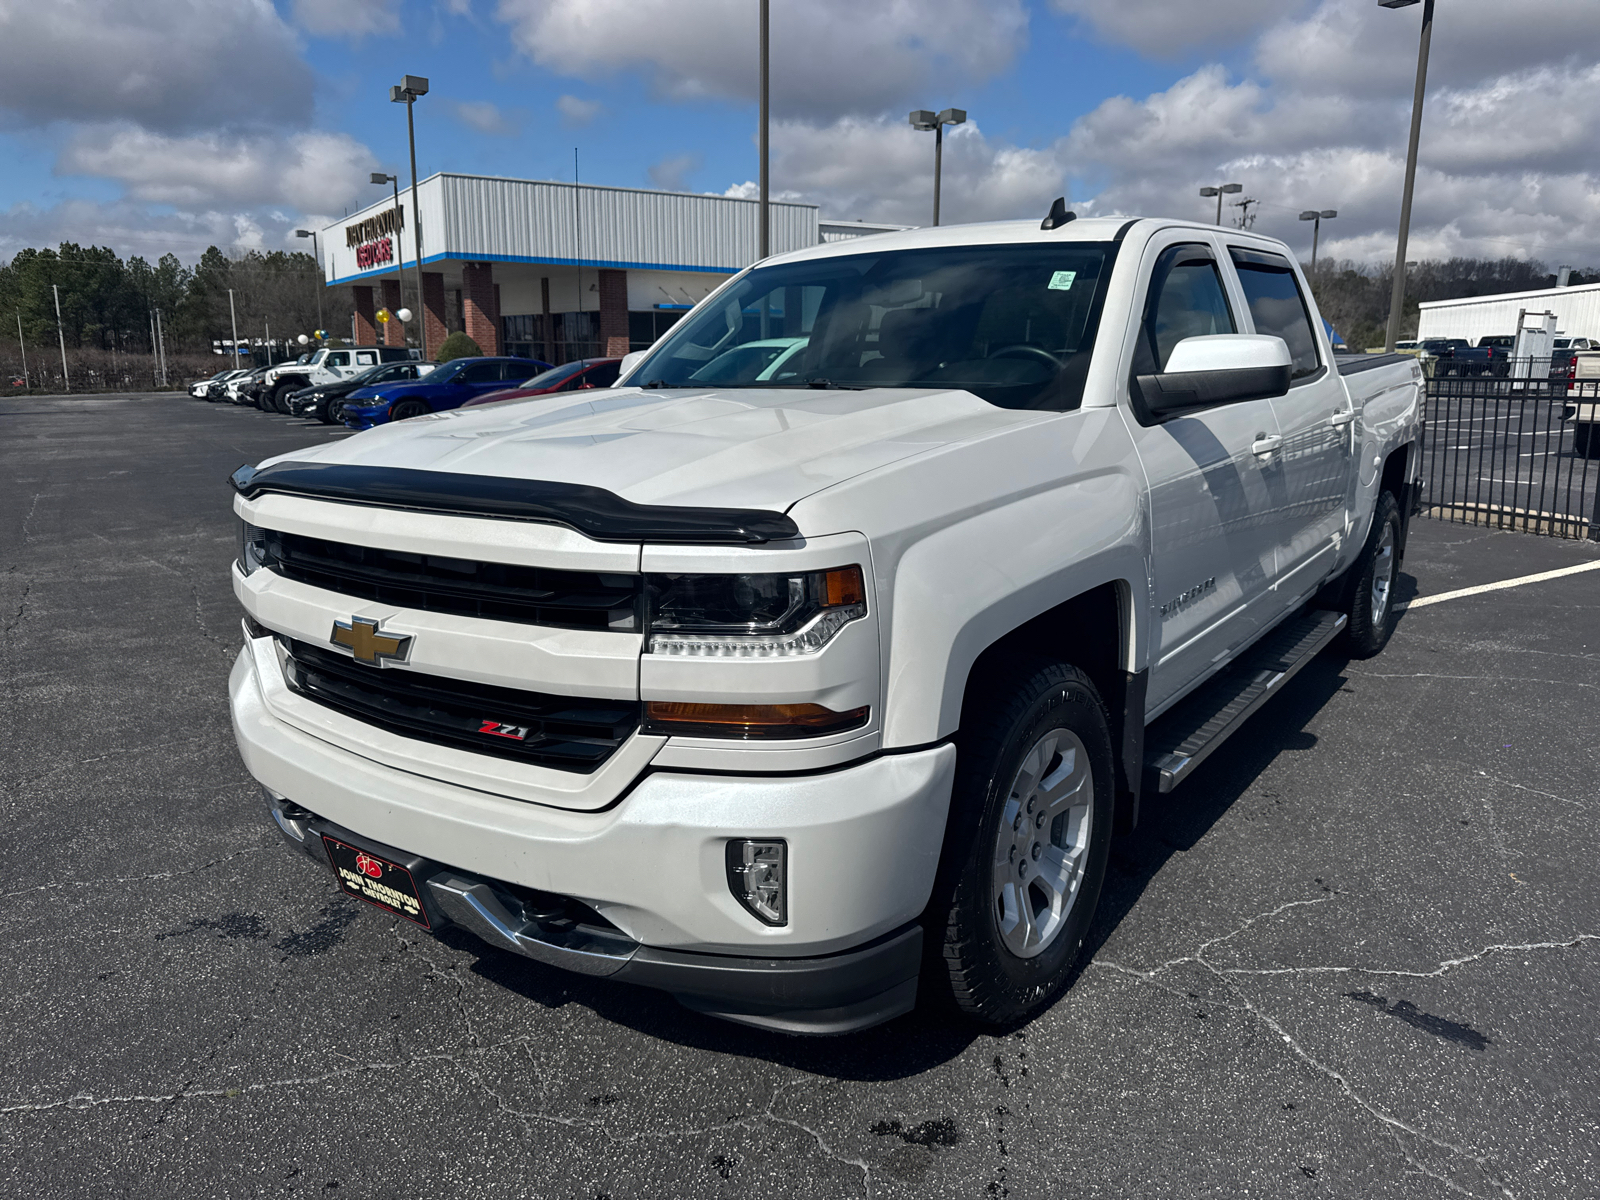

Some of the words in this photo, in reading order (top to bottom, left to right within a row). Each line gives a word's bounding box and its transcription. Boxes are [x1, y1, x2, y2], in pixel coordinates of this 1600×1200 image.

[356, 244, 372, 269] USED
[372, 237, 391, 264] CARS
[479, 719, 529, 740] Z71
[338, 866, 365, 887] JOHN
[364, 878, 421, 910] THORNTON
[362, 886, 401, 910] CHEVROLET
